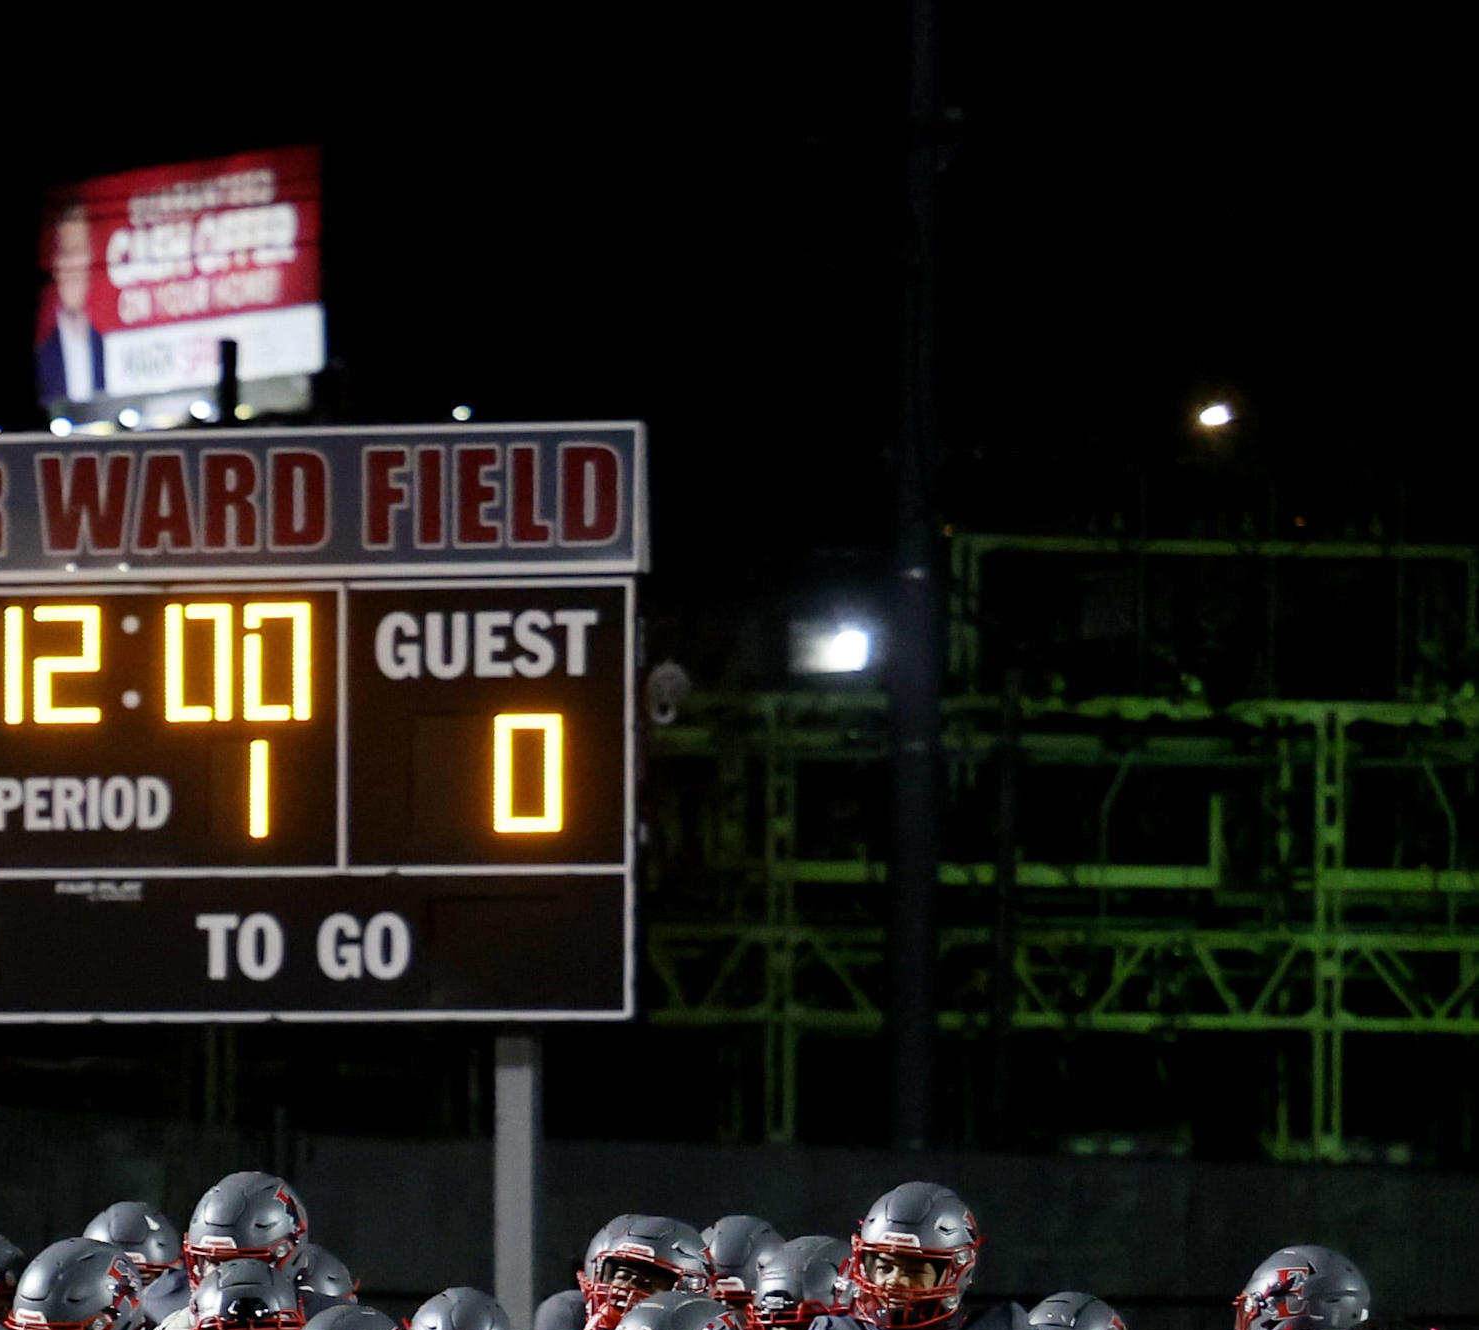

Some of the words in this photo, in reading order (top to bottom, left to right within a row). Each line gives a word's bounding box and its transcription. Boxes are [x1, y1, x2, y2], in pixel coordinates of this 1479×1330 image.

[35, 444, 331, 556] WARD
[361, 439, 623, 550] FIELD
[2, 601, 312, 726] 12:00
[375, 609, 599, 681] GUEST
[249, 738, 270, 839] 1
[493, 712, 564, 834] 0
[196, 912, 284, 982] TO
[316, 912, 412, 982] GO
